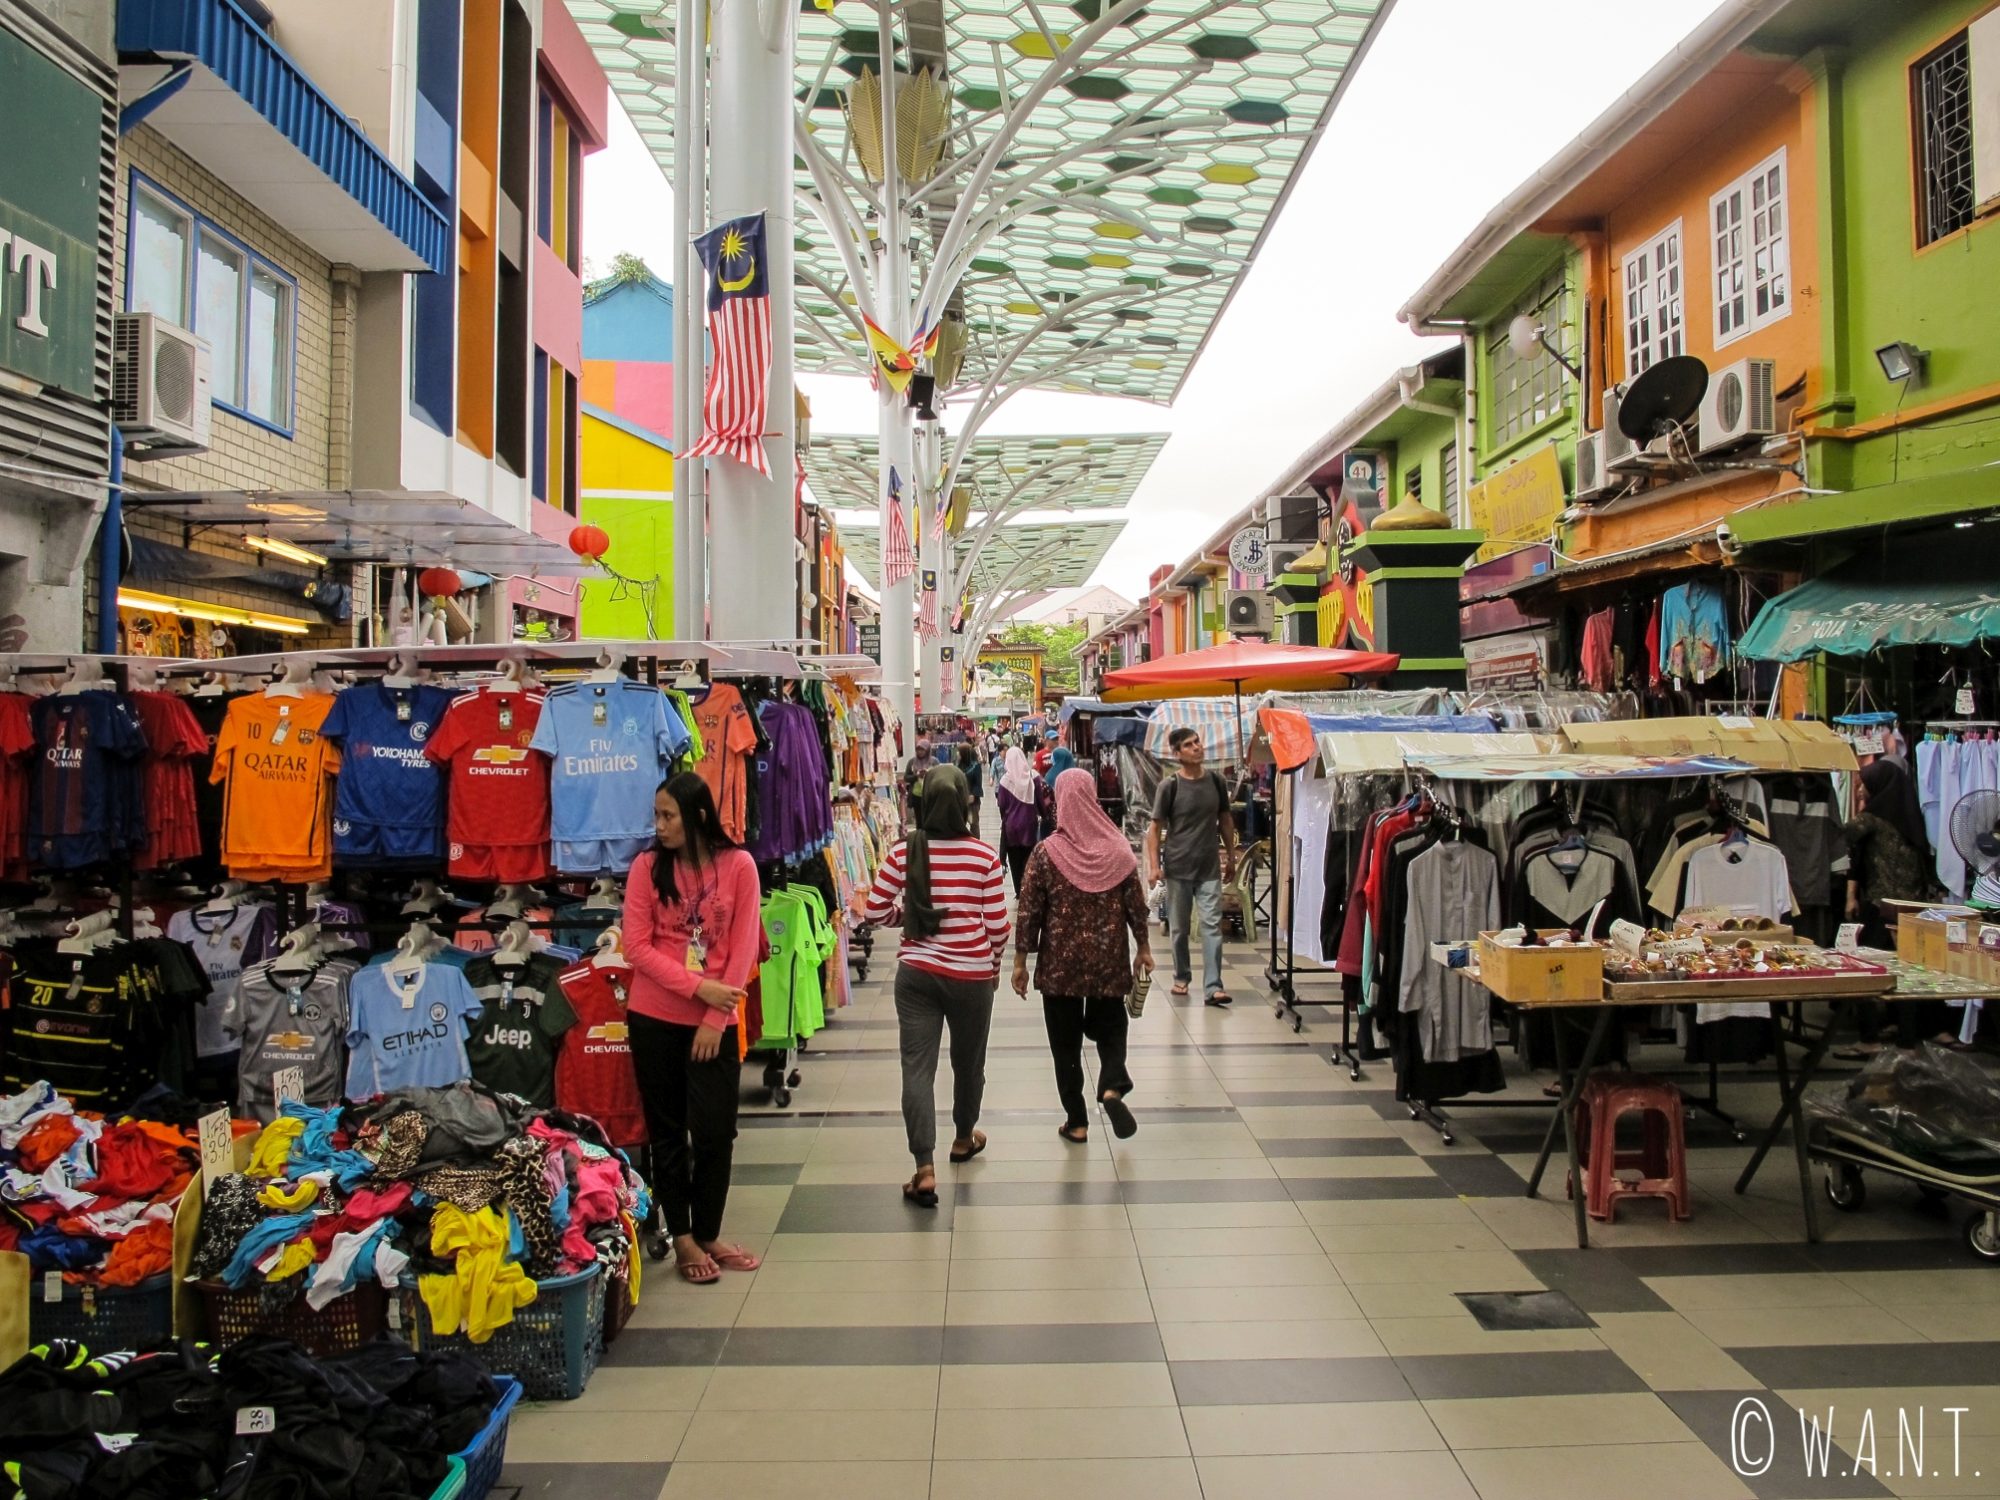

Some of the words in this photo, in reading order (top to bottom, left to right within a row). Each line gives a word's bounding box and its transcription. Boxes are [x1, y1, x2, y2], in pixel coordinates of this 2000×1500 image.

[1352, 466, 1367, 480] 41
[247, 721, 262, 739] 10
[372, 746, 426, 760] YOKOHAM
[244, 752, 307, 772] QATAR
[401, 759, 431, 768] TYRES
[564, 753, 638, 776] Emirates
[257, 769, 306, 783] AIRWAYS
[468, 766, 529, 776] CHEVROLET
[31, 985, 53, 1006] 20
[383, 1024, 448, 1050] ETIHAD
[484, 1024, 532, 1050] Jeep
[262, 1051, 316, 1060] CHEVROLET
[584, 1045, 632, 1053] CHEVROL
[250, 1409, 264, 1430] 38
